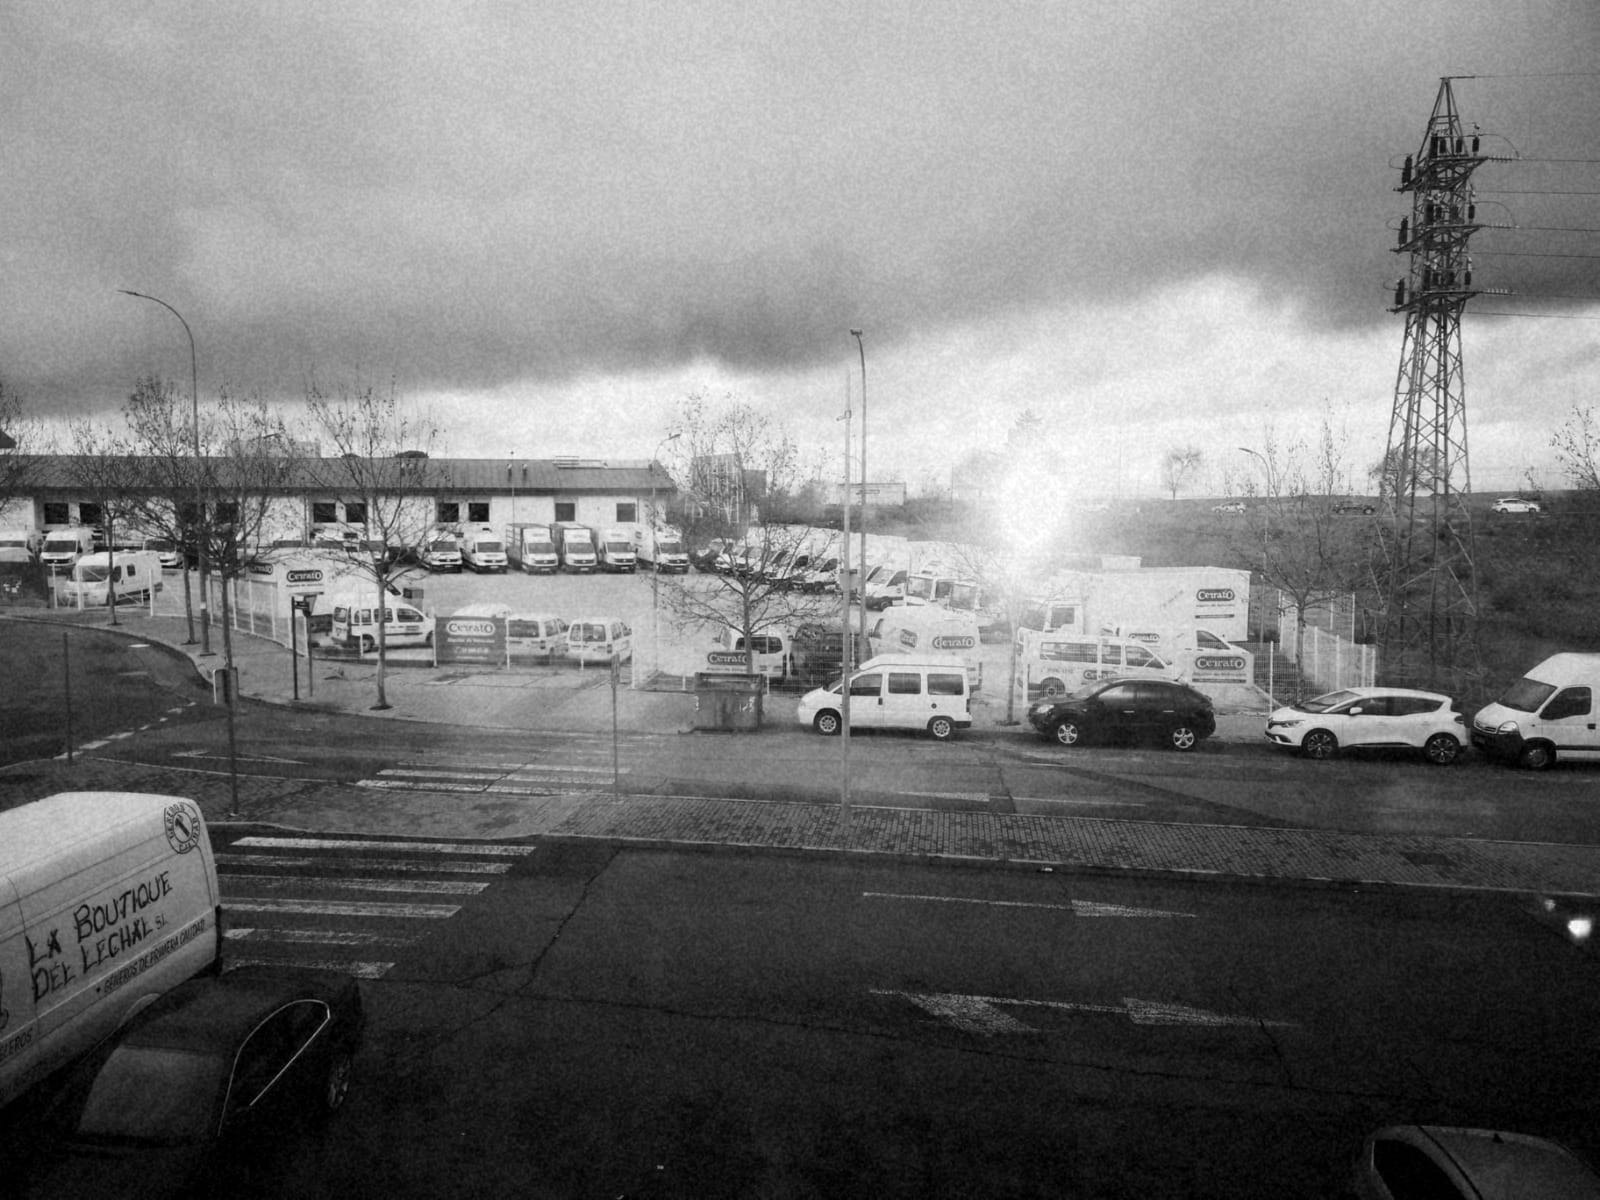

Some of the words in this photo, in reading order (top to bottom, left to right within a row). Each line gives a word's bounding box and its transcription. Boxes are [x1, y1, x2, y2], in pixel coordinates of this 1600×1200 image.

[25, 928, 62, 968] LA
[73, 870, 173, 944] BOUTIQUE
[31, 961, 76, 1004] DEL
[80, 916, 153, 974] LECHAL
